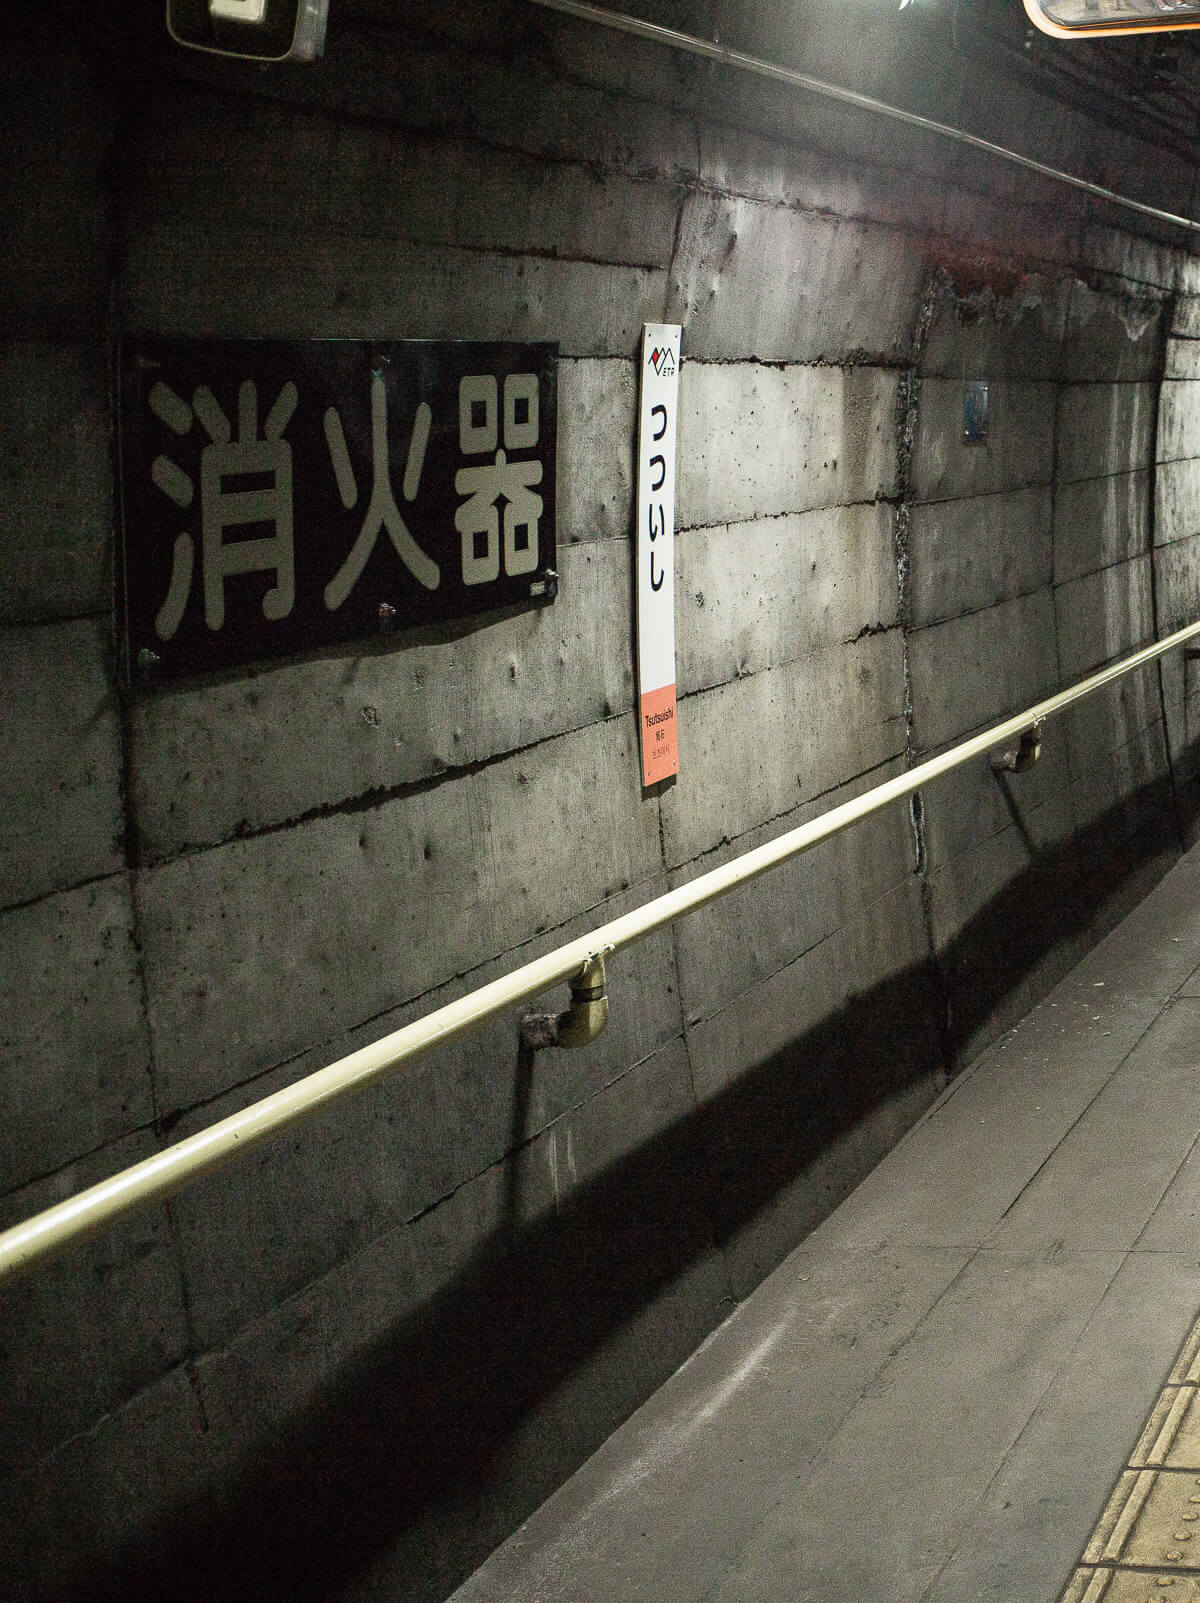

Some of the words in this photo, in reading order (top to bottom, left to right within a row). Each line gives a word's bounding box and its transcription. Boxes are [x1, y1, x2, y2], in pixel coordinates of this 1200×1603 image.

[148, 369, 544, 641] 消火器
[649, 403, 668, 592] つついし
[645, 706, 674, 728] Tsutsuishi
